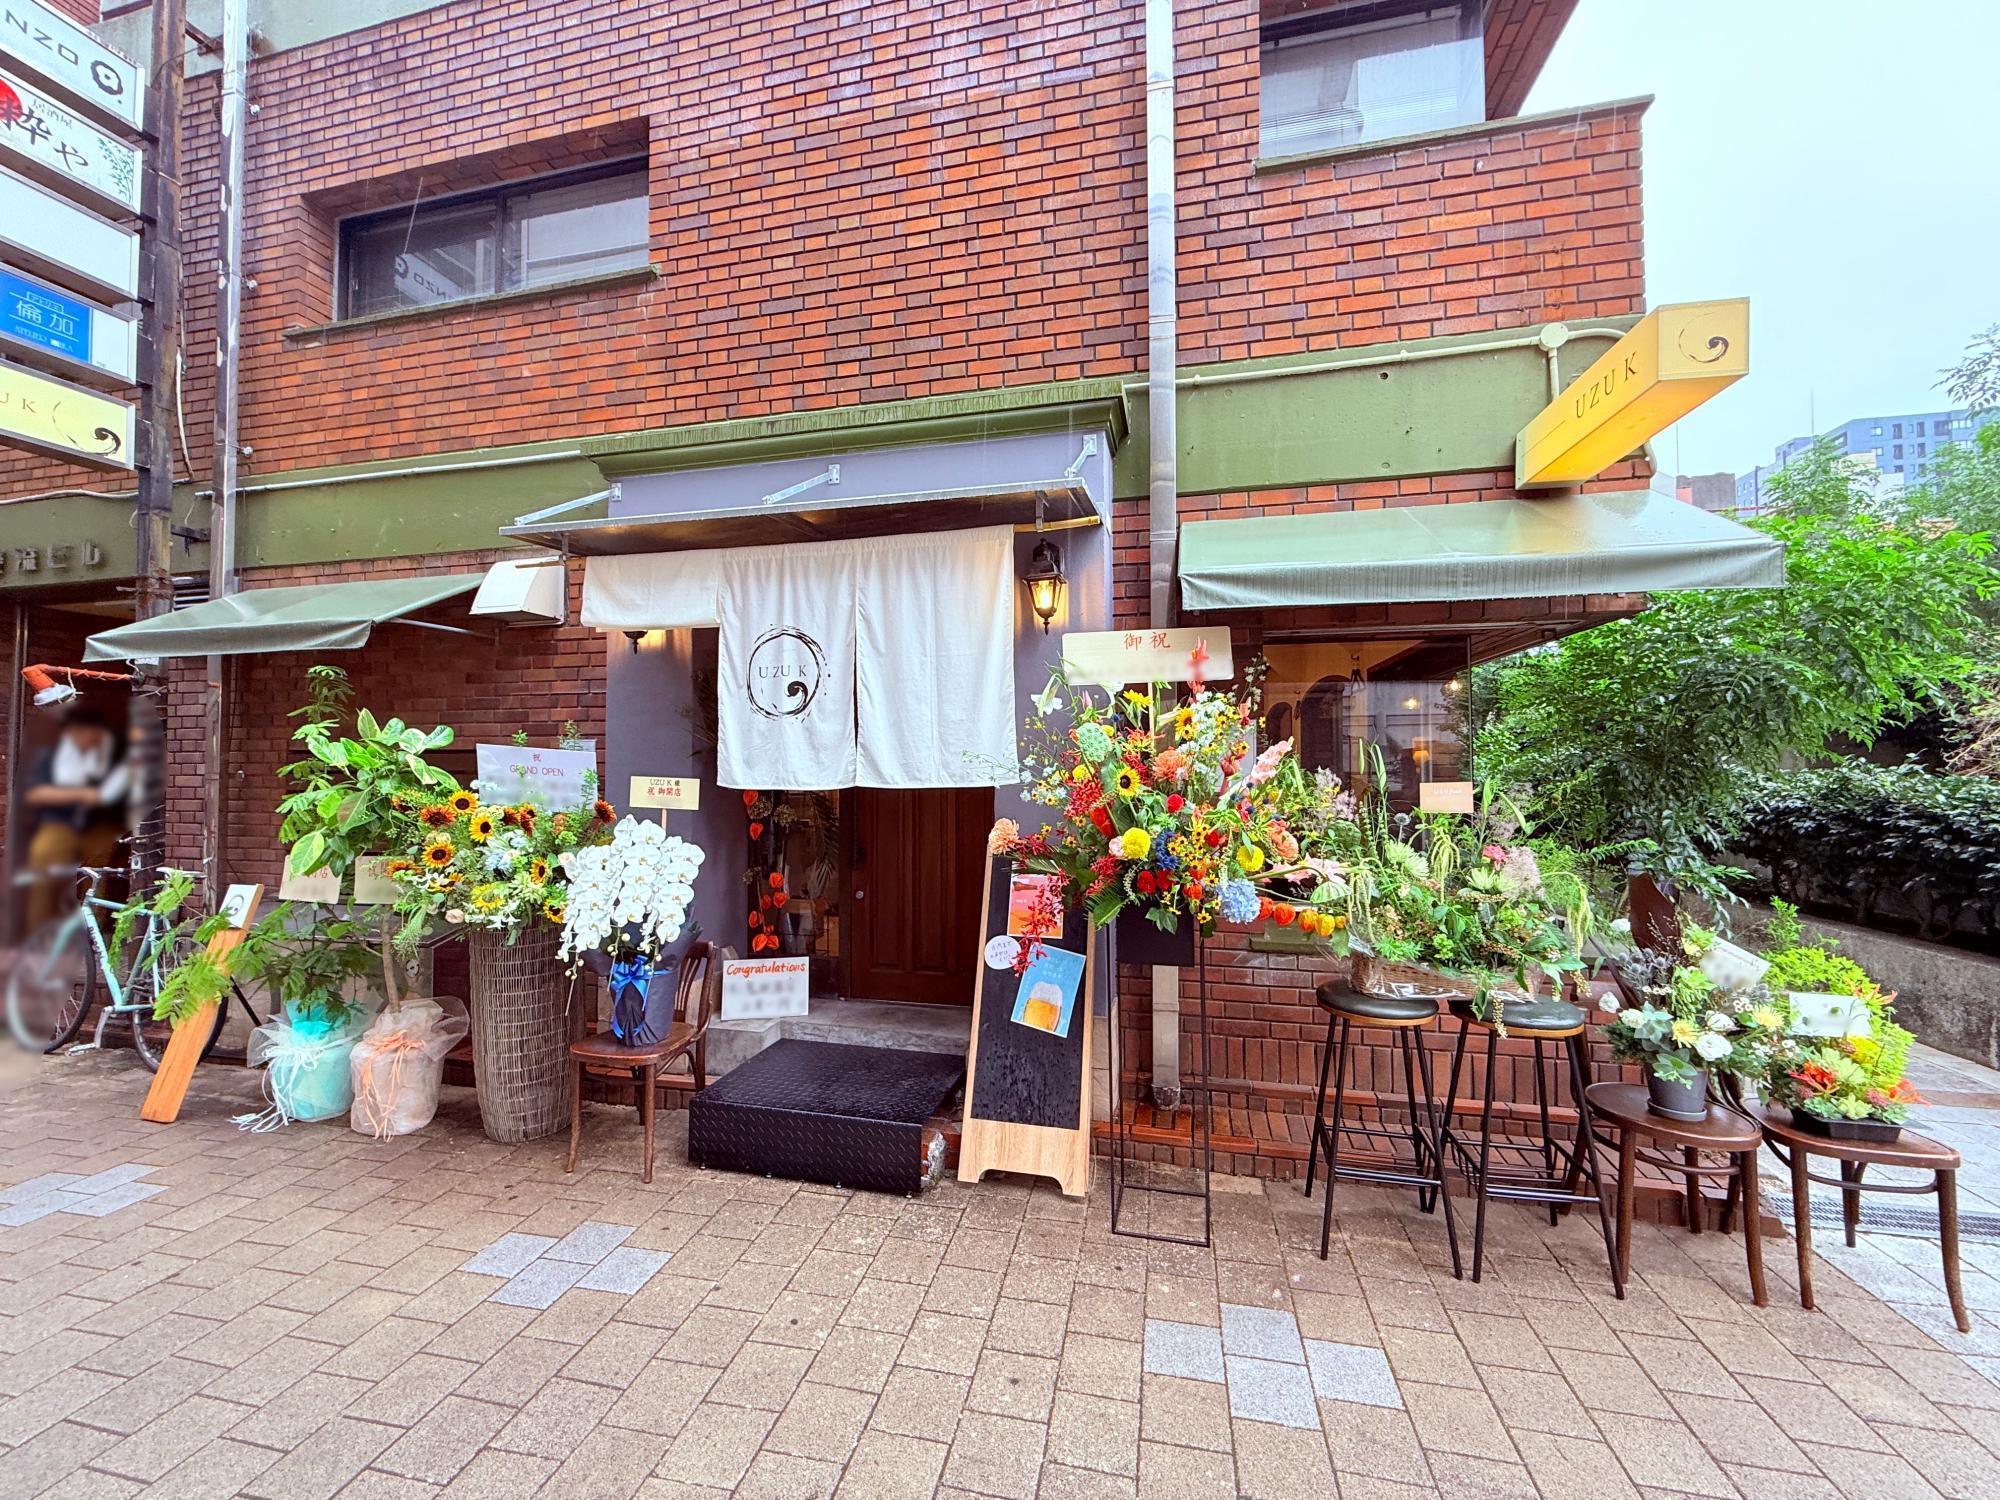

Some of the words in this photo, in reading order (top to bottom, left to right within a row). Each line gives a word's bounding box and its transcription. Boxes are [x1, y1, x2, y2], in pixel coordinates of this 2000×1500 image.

[1123, 632, 1171, 650] 御祝
[542, 767, 564, 777] OPEN
[726, 960, 806, 978] Congratulations
